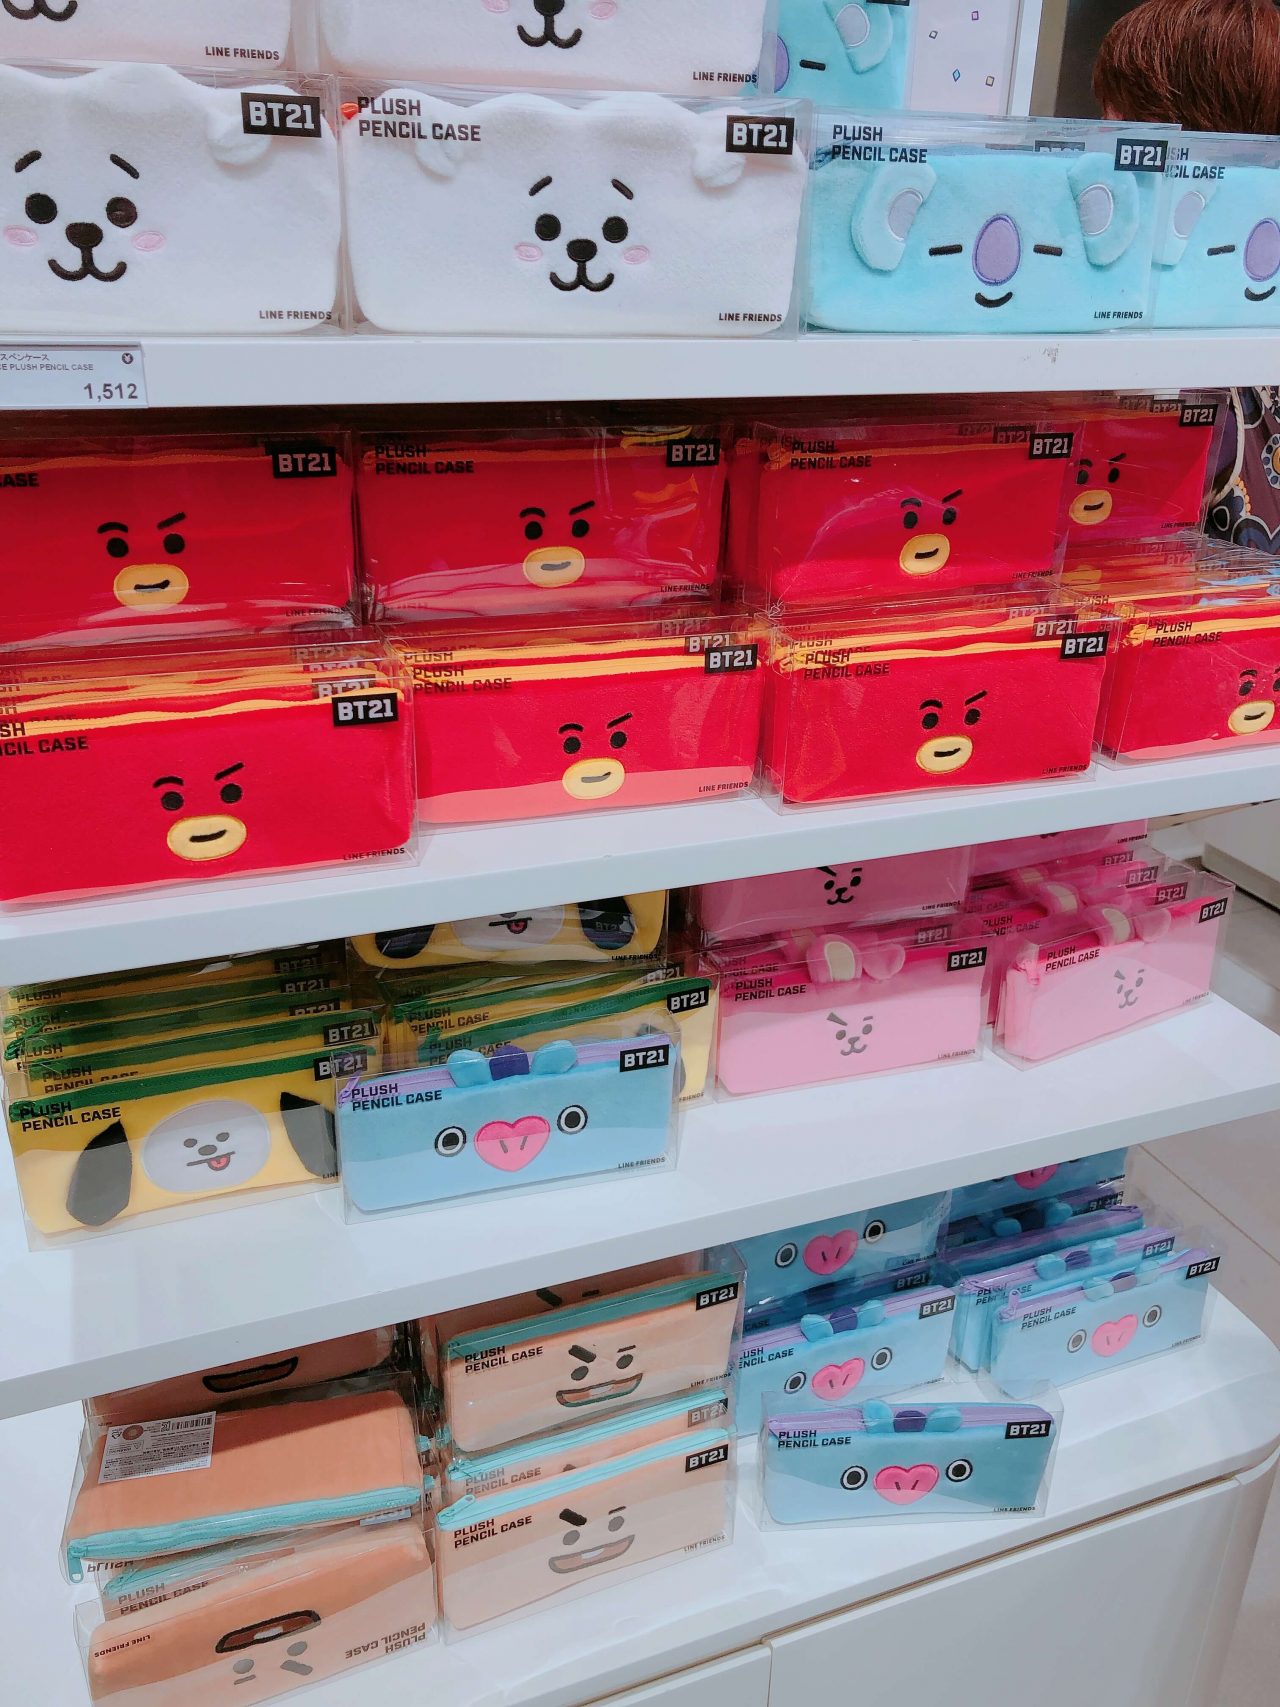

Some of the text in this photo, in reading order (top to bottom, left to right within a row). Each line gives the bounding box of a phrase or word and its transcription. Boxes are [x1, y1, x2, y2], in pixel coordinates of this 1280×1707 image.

[205, 46, 280, 61] LINE FRIENDS
[693, 71, 757, 83] LINE FRIENDS
[248, 101, 315, 129] BT21
[358, 97, 421, 116] PLUSH
[359, 119, 481, 141] PENCIL CASE
[733, 123, 788, 147] BT21
[833, 125, 882, 142] PLUSH
[831, 145, 927, 164] PENCIL CASE
[1120, 145, 1162, 167] BT21
[1192, 165, 1225, 180] CASE
[259, 309, 331, 321] LINE FRIENDS
[719, 313, 782, 322] LINE FRIENDS
[1094, 311, 1143, 320] LINE FRIENDS
[10, 363, 37, 371] PLUSH
[84, 383, 138, 402] 1,512
[1183, 408, 1214, 423] BT21
[374, 444, 427, 459] PLUSH
[671, 444, 715, 463] BT21
[792, 441, 835, 454] PLUSH
[1033, 438, 1069, 456] BT21
[278, 453, 331, 473] BT21
[375, 460, 475, 476] PENCIL CASE
[790, 456, 872, 470] PENCIL CASE
[660, 583, 710, 593] LINE FRIENDS
[1035, 620, 1074, 637] BT21
[1156, 622, 1192, 634] PLUSH
[689, 634, 731, 653] BT21
[1065, 637, 1105, 655] BT21
[1153, 632, 1221, 648] PENCIL CASE
[709, 649, 753, 669] BT21
[805, 651, 850, 665] PLUSH
[413, 666, 464, 679] PLUSH
[804, 664, 890, 681] PENCIL CASE
[414, 677, 513, 695] PENCIL CASE
[337, 699, 394, 722] BT21
[39, 736, 88, 753] CASE
[1058, 764, 1087, 773] FRIENDS
[698, 781, 749, 793] LINE FRIENDS
[343, 847, 405, 861] LINE FRIENDS
[1128, 869, 1156, 884] BT21
[1158, 885, 1186, 900] BT21
[1201, 901, 1225, 919] BT21
[950, 951, 983, 968] BT21
[1045, 949, 1100, 973] PENCIL CASE
[1047, 945, 1076, 960] PLUSH
[285, 978, 327, 994] BT21
[735, 978, 773, 990] PLUSH
[16, 989, 62, 1003] PLUSH
[671, 991, 706, 1011] BT21
[734, 984, 807, 1002] PENCIL CASE
[409, 1006, 451, 1022] PLUSH
[411, 1012, 490, 1034] PENCIL CASE
[328, 1022, 371, 1043] BT21
[319, 1055, 364, 1076] BT21
[623, 1048, 666, 1068] BT21
[42, 1065, 93, 1083] PLUSH
[352, 1083, 399, 1099] PLUSH
[352, 1089, 443, 1112] PENCIL CASE
[19, 1101, 73, 1119] PLUSH
[22, 1106, 122, 1132] PENCIL CASE
[635, 1157, 666, 1167] FRIENDS
[1145, 1240, 1174, 1256] BT21
[1188, 1261, 1217, 1276] BT21
[699, 1286, 736, 1307] BT21
[922, 1299, 952, 1315] BT21
[1022, 1306, 1053, 1321] PLUSH
[1020, 1306, 1077, 1330] PENCIL CASE
[464, 1346, 506, 1364] PLUSH
[464, 1346, 544, 1374] PENCIL CASE
[768, 1348, 795, 1362] CASE
[690, 1403, 725, 1424] BT21
[778, 1430, 817, 1439] PLUSH
[1009, 1423, 1048, 1437] BT21
[777, 1436, 852, 1449] PENCIL CASE
[688, 1448, 725, 1469] BT21
[465, 1467, 505, 1487] PLUSH
[466, 1467, 542, 1496] PENCIL CASE
[453, 1518, 495, 1539] PLUSH
[453, 1515, 533, 1549] PENCIL CASE
[117, 1583, 165, 1605] PLUSH
[120, 1581, 209, 1615] PENCIL CASE
[94, 1634, 151, 1658] LINE FRIENDS
[345, 1622, 426, 1659] PENCIL CASE
[385, 1632, 426, 1654] PLUSH
